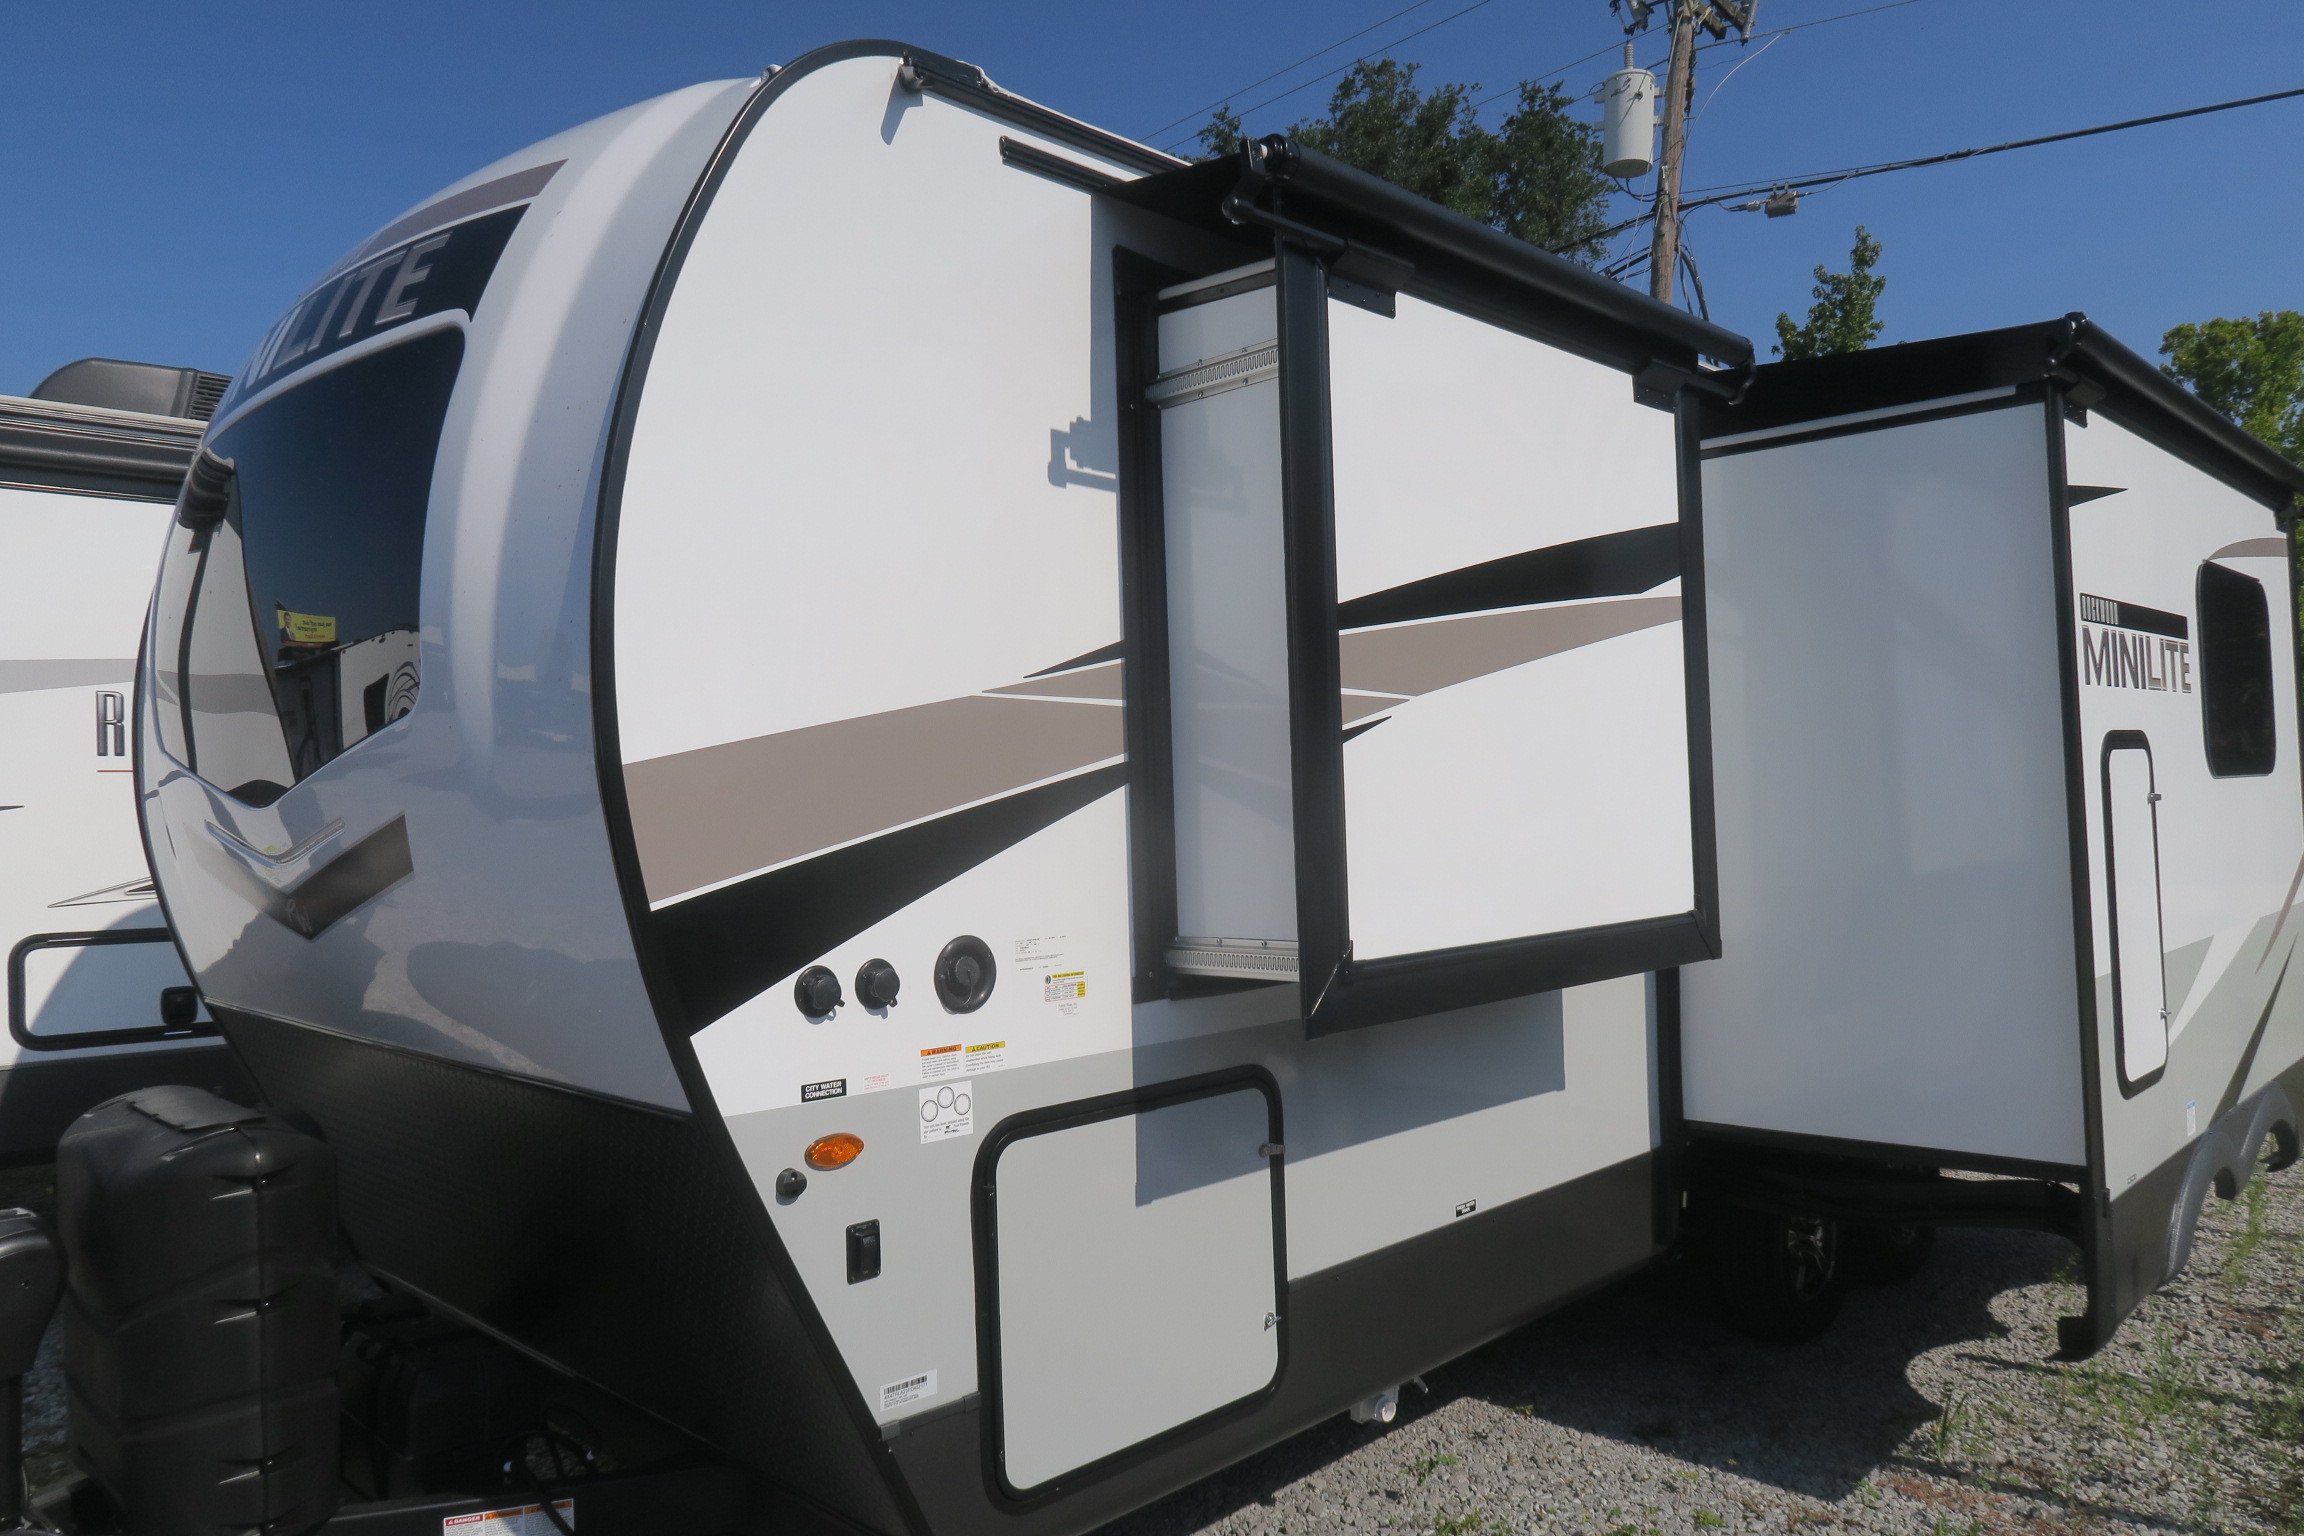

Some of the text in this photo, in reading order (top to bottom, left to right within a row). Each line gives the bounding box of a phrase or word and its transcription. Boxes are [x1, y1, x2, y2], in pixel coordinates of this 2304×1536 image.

[2081, 625, 2192, 693] MINILITE
[976, 1043, 1000, 1052] CAUTION
[805, 1080, 842, 1092] CITY WATER
[805, 1087, 843, 1099] CONNECTION
